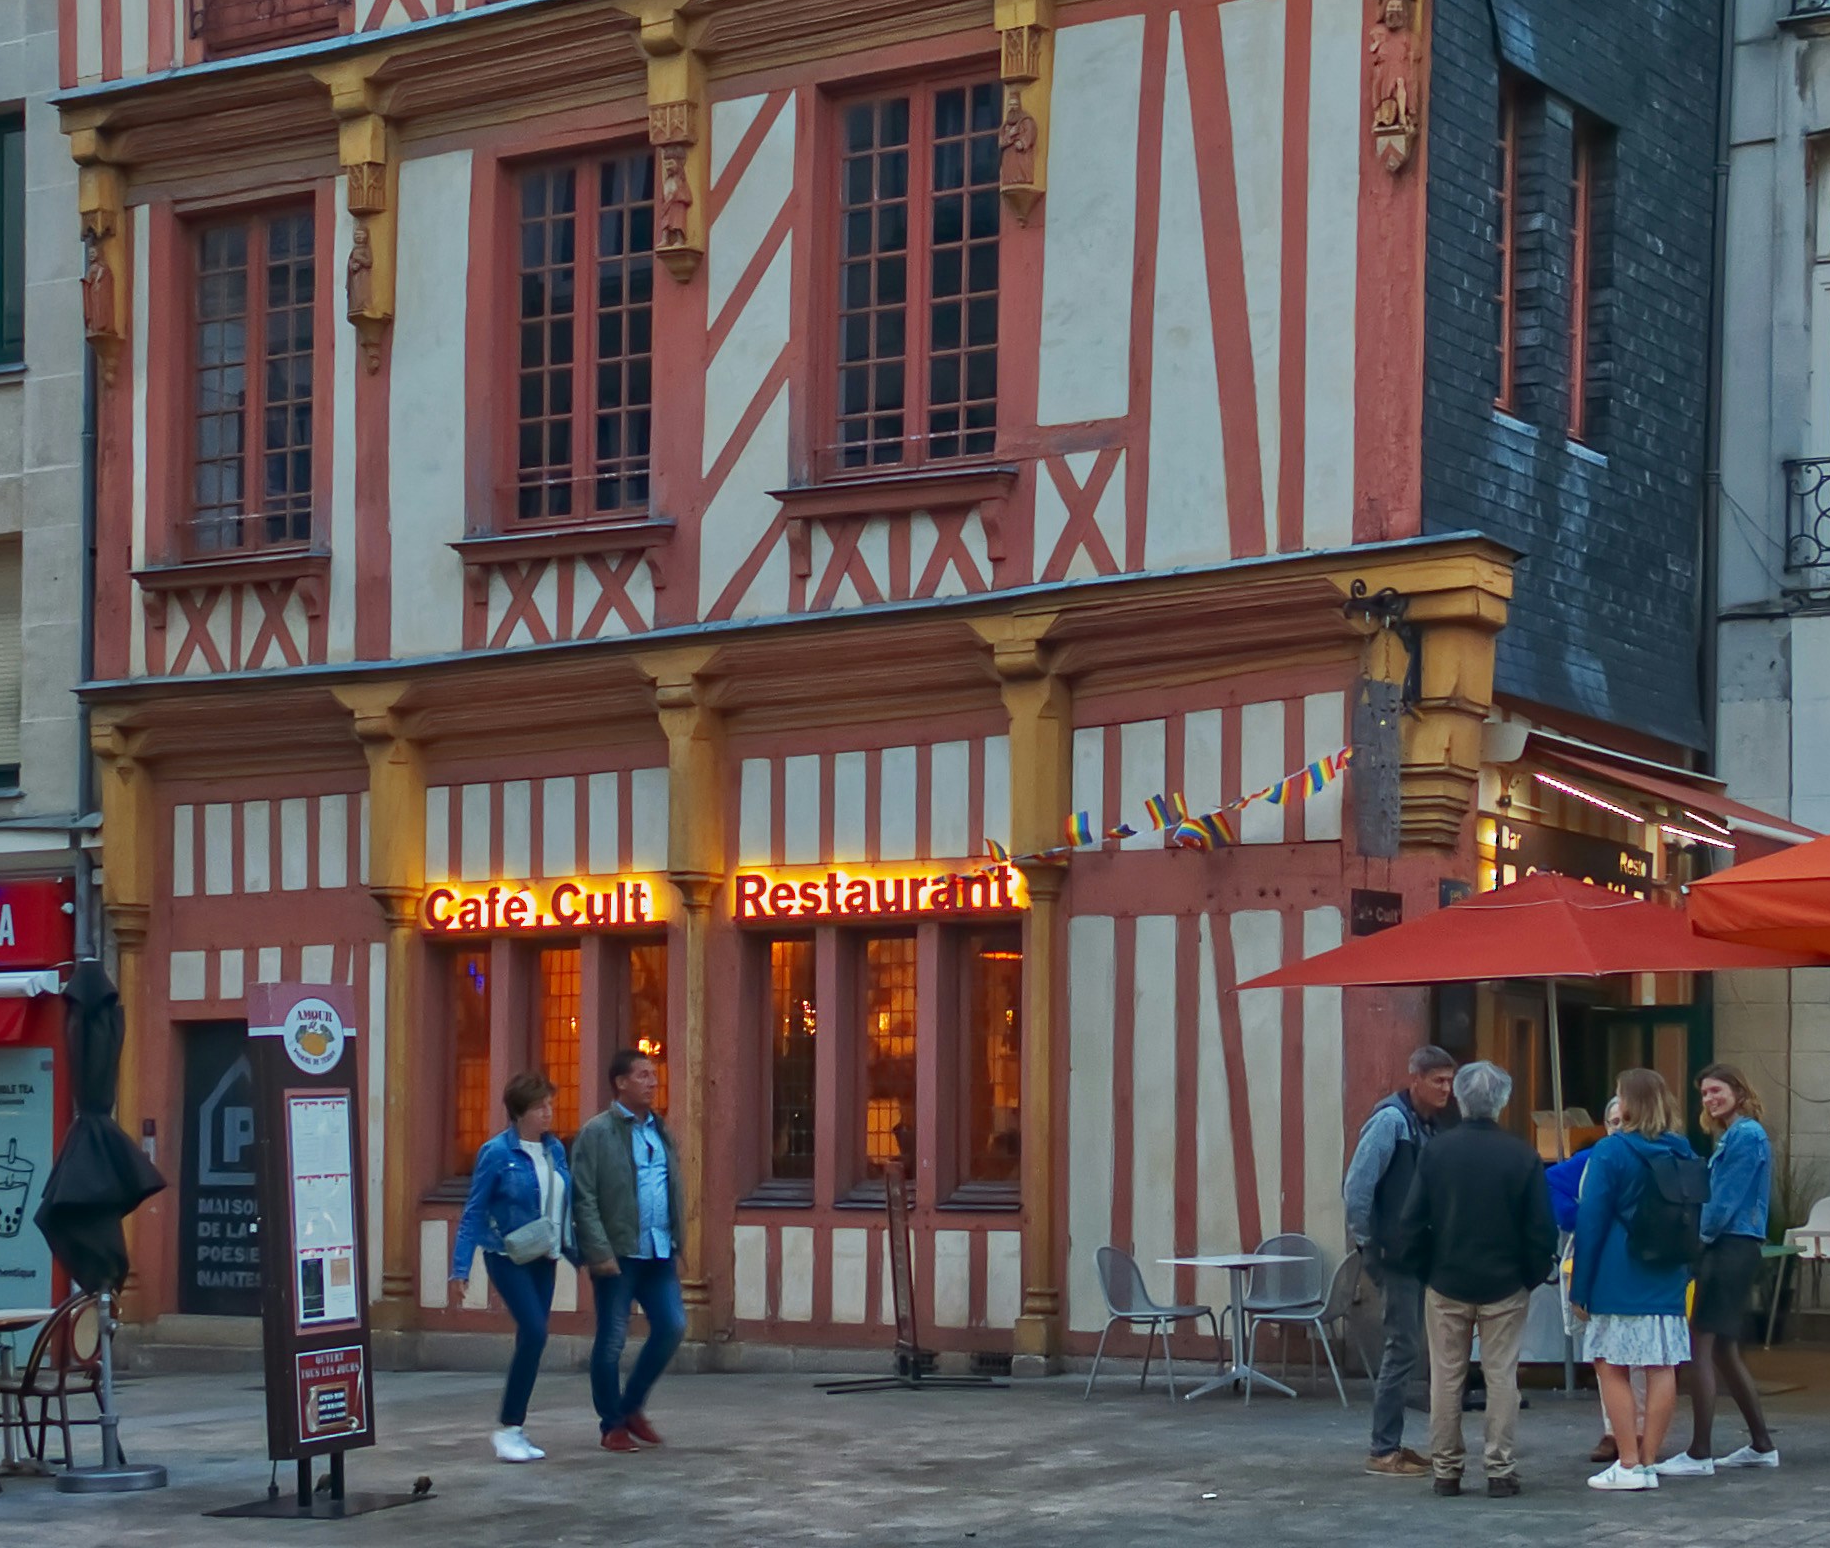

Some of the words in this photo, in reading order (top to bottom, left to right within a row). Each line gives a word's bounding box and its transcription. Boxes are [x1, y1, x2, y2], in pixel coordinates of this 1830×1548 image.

[1501, 824, 1522, 850] Bar
[735, 865, 1013, 917] Restaurant
[551, 882, 647, 925] Cult
[297, 1010, 333, 1023] AMOUR
[19, 1083, 35, 1095] TEA
[198, 1221, 221, 1237] DE
[226, 1222, 248, 1238] LA
